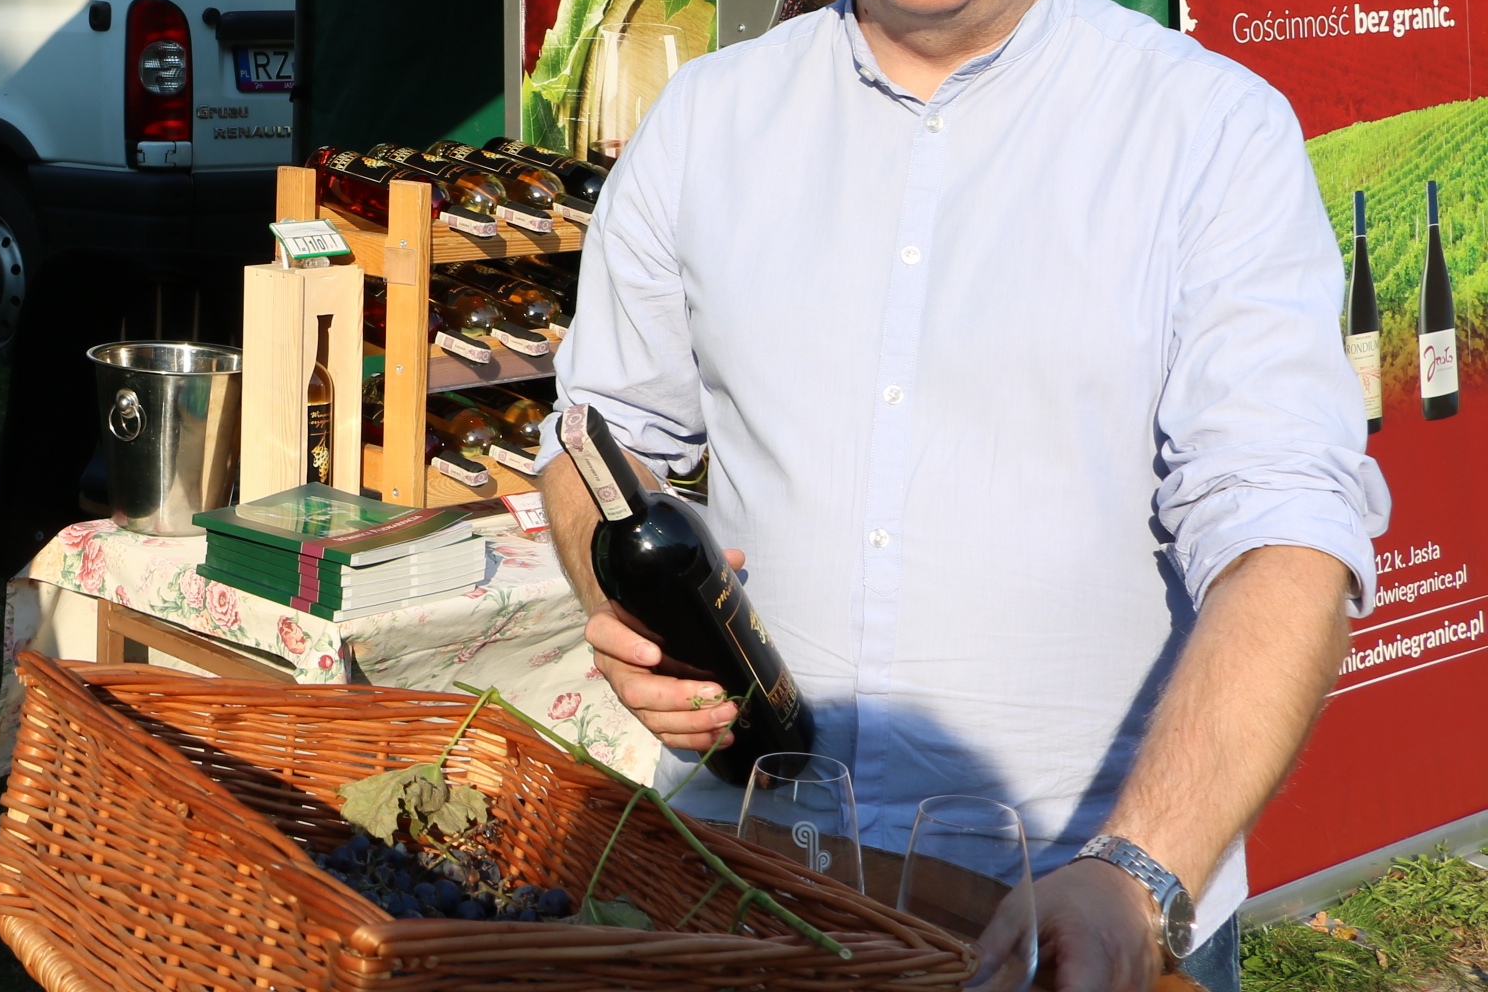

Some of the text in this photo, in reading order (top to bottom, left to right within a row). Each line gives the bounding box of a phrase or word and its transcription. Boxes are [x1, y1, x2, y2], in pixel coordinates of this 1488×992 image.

[1232, 6, 1350, 44] Gościnność
[1354, 3, 1390, 35] bez
[240, 70, 250, 78] PL
[213, 125, 293, 140] RENAULT
[1375, 541, 1441, 575] 12 k. Jasła
[1373, 563, 1468, 608] dwiegranice.pl
